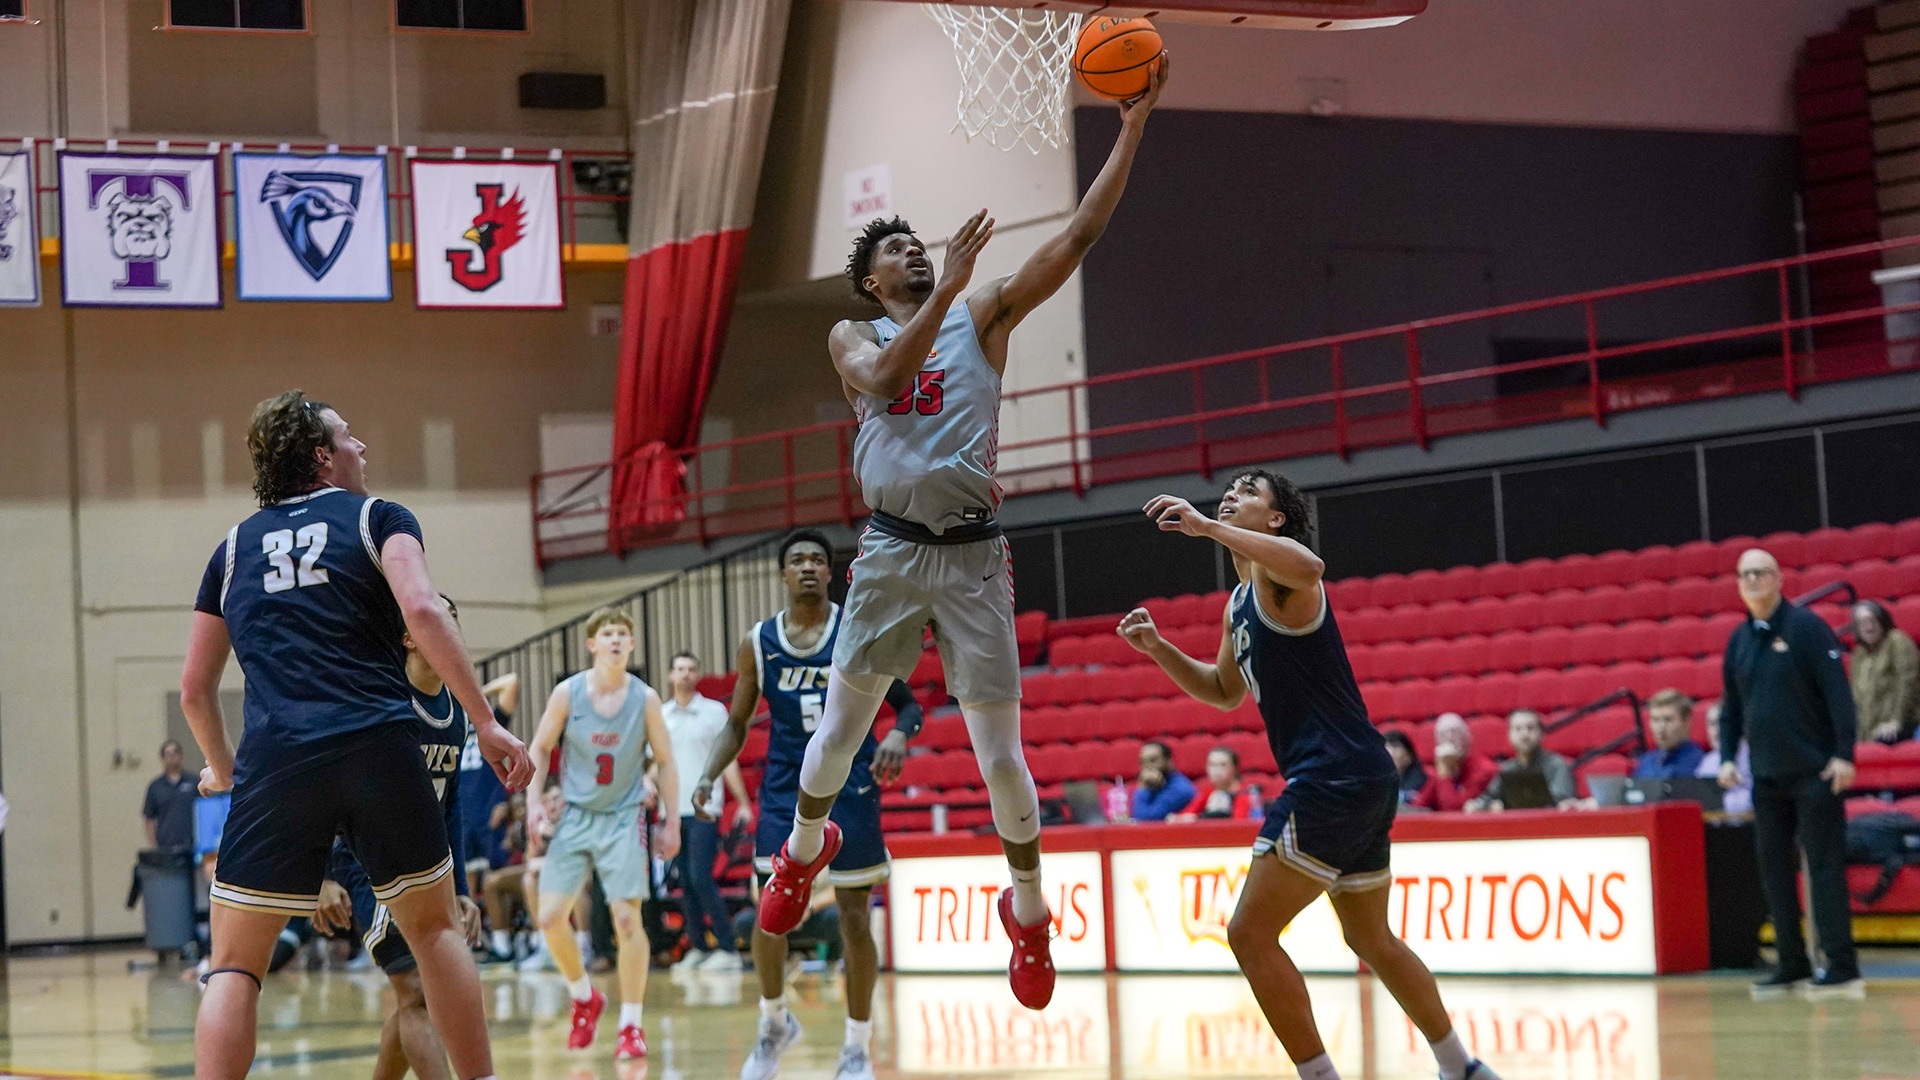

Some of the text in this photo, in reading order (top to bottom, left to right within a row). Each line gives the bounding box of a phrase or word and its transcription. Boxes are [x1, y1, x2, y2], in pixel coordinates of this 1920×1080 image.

[262, 521, 329, 594] 32
[799, 692, 823, 733] 5
[596, 753, 614, 785] 3
[914, 883, 1088, 942] TRITNS
[1392, 872, 1626, 942] TRITONS
